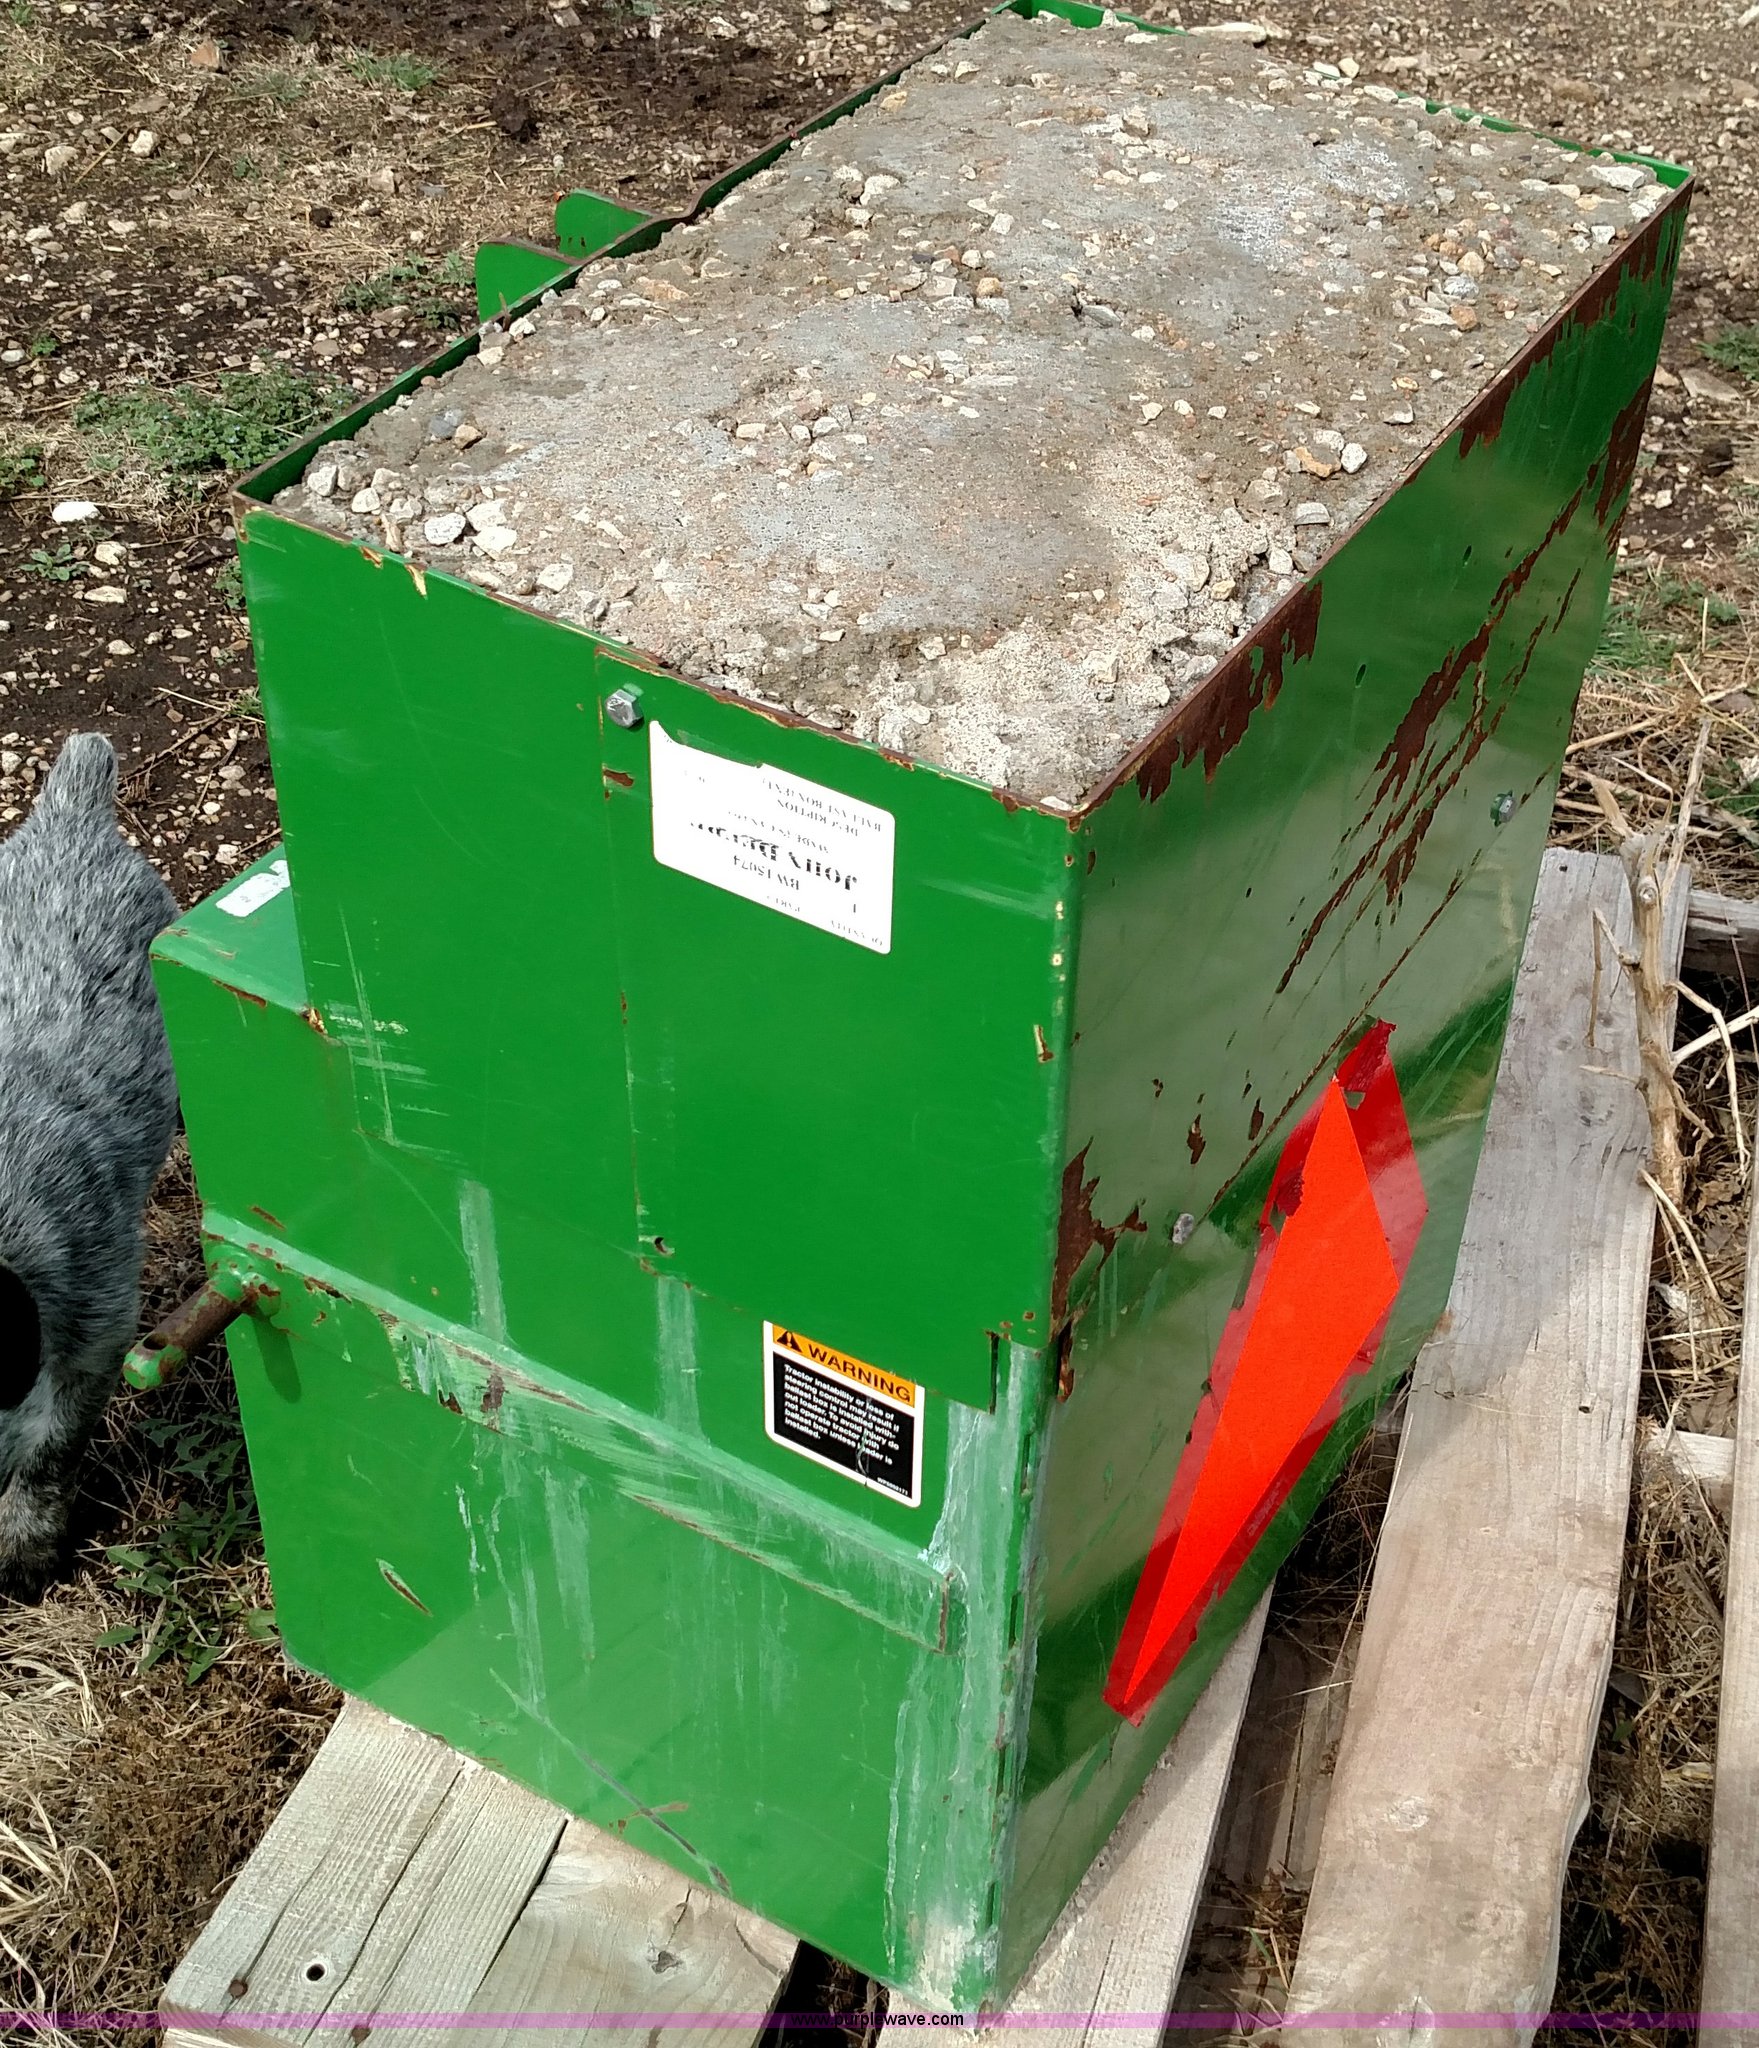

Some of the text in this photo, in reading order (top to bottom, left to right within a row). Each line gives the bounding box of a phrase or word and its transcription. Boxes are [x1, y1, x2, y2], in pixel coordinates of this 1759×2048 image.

[783, 1363, 894, 1421] Tractor instability or loss of
[783, 1373, 818, 1395] steering
[818, 1389, 848, 1408] control
[848, 1404, 867, 1418] may
[867, 1412, 892, 1429] result
[808, 1344, 911, 1402] WARNING
[783, 1381, 811, 1400] ballast
[812, 1394, 828, 1408] box
[829, 1403, 837, 1412] is
[838, 1407, 873, 1429] installed
[784, 1390, 899, 1451] out loader. To avoid injury do
[784, 1399, 879, 1449] not operate tractor with
[784, 1416, 821, 1439] installed.
[784, 1407, 893, 1465] ballast box unless loader is
